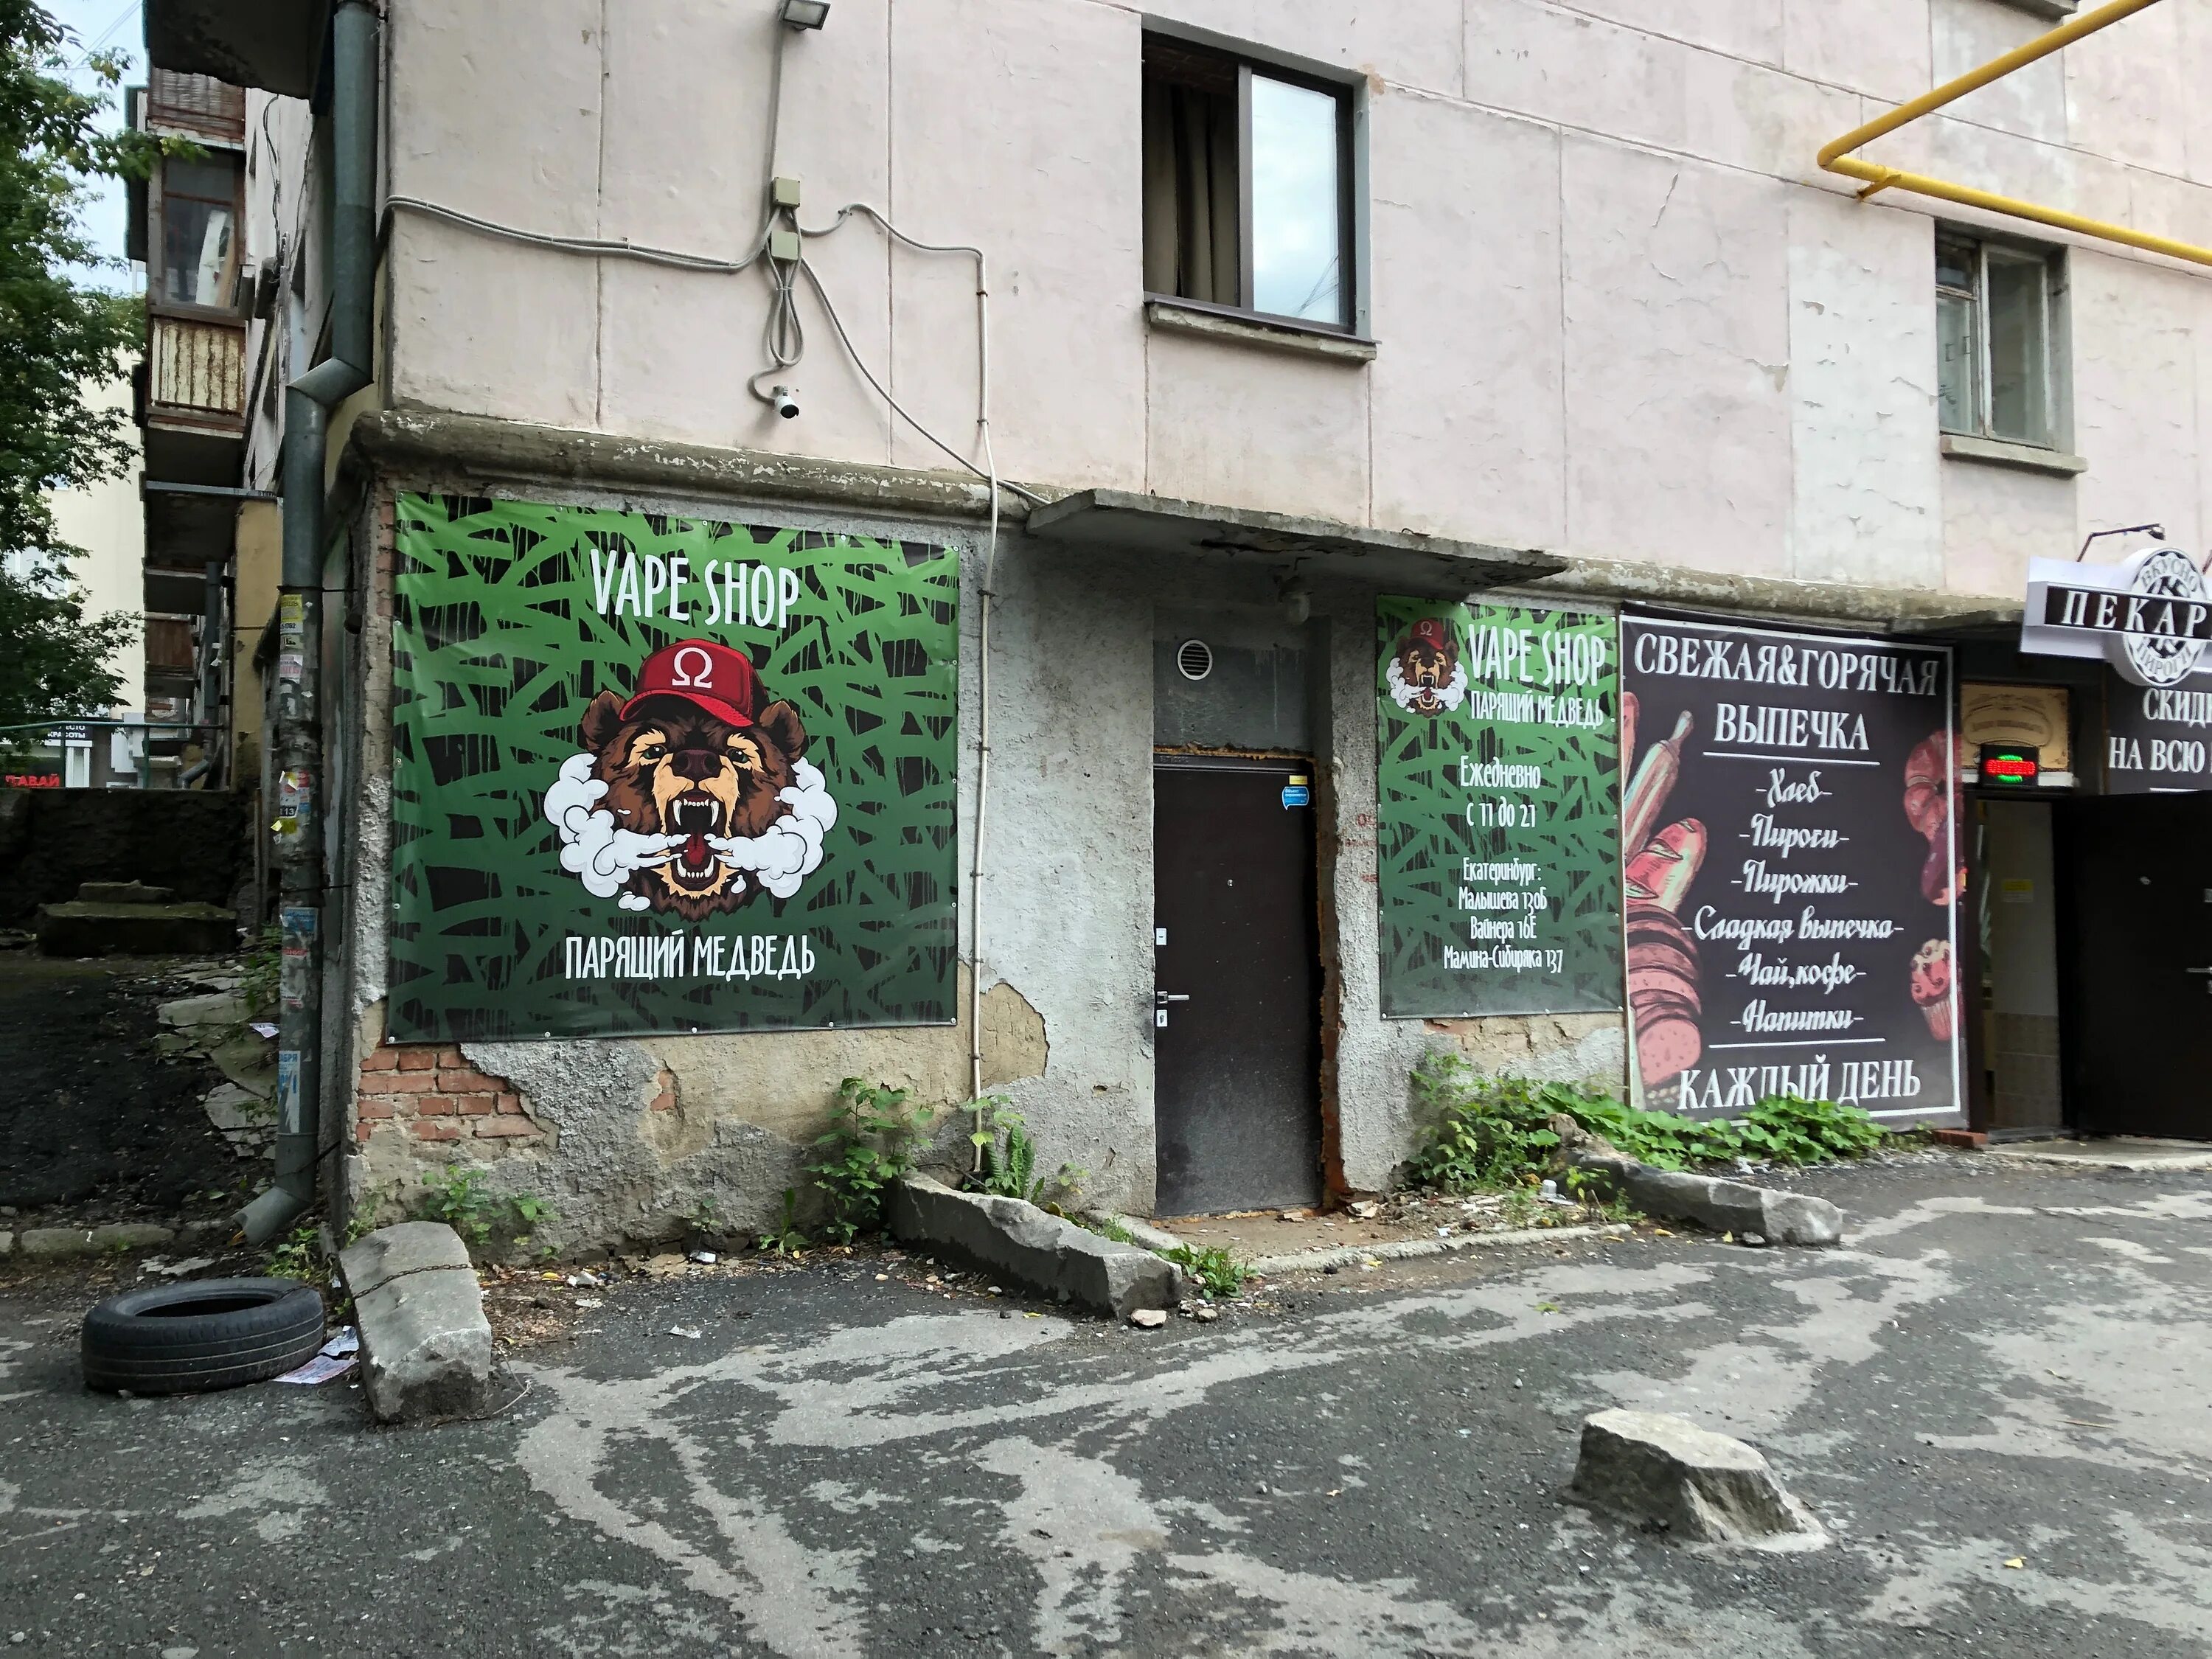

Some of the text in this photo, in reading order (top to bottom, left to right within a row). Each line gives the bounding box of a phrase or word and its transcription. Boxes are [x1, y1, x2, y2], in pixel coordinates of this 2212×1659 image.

[590, 549, 800, 629] VAPE SHOP
[2061, 589, 2212, 639] ПЕКАР
[1468, 624, 1606, 686] VAPE SHOP
[1634, 632, 1939, 697] СВЕЖАЯ&ГОРЯЧАЯ
[1470, 689, 1604, 730] ПАРЯЩИЙ МЕДВЕДЬ
[1714, 702, 1870, 751] ВЫПЕЧКА
[1460, 755, 1541, 789] Ежедневно
[2109, 737, 2143, 770] НА
[2149, 739, 2205, 773] ВСЮ
[1478, 802, 1493, 827] 11
[1498, 796, 1515, 827] до
[1520, 804, 1536, 827] 21
[1463, 857, 1542, 886] Екатеринбург:
[1458, 886, 1548, 917] Малышева 130Б
[1470, 915, 1537, 944] Вайнера 16Е
[565, 928, 815, 983] ПАРЯЩИЙ МЕДВЕДЬ
[1444, 944, 1564, 974] Мамина-Сибиряка 137
[1678, 1054, 1921, 1110] КАЖДЫЙ ДЕНЬ
